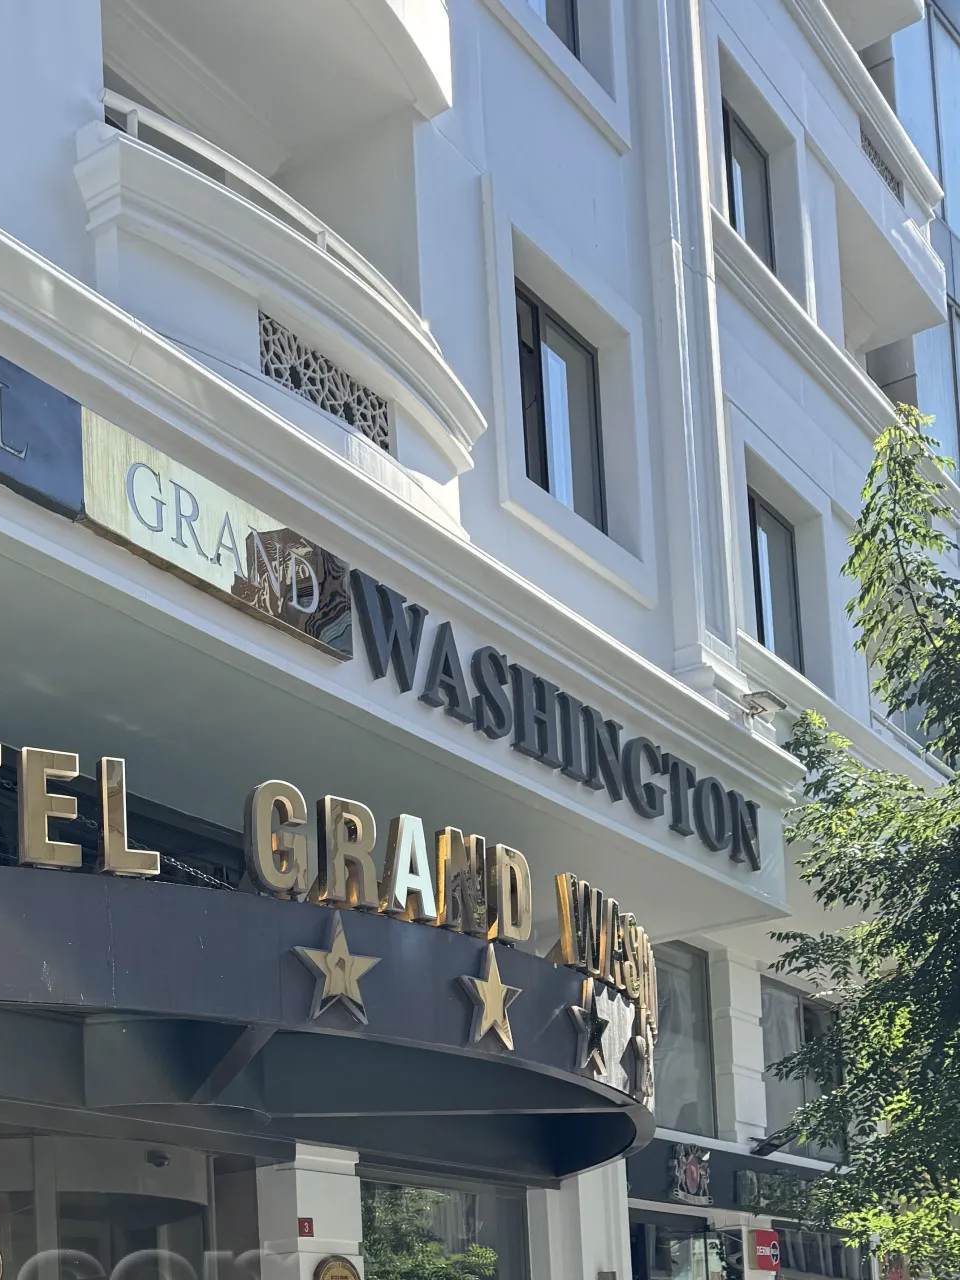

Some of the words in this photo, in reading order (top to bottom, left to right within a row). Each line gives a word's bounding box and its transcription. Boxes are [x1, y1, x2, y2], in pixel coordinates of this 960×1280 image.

[126, 462, 320, 614] GRAND
[350, 569, 761, 871] WASHINGTON
[244, 780, 532, 944] GRAND
